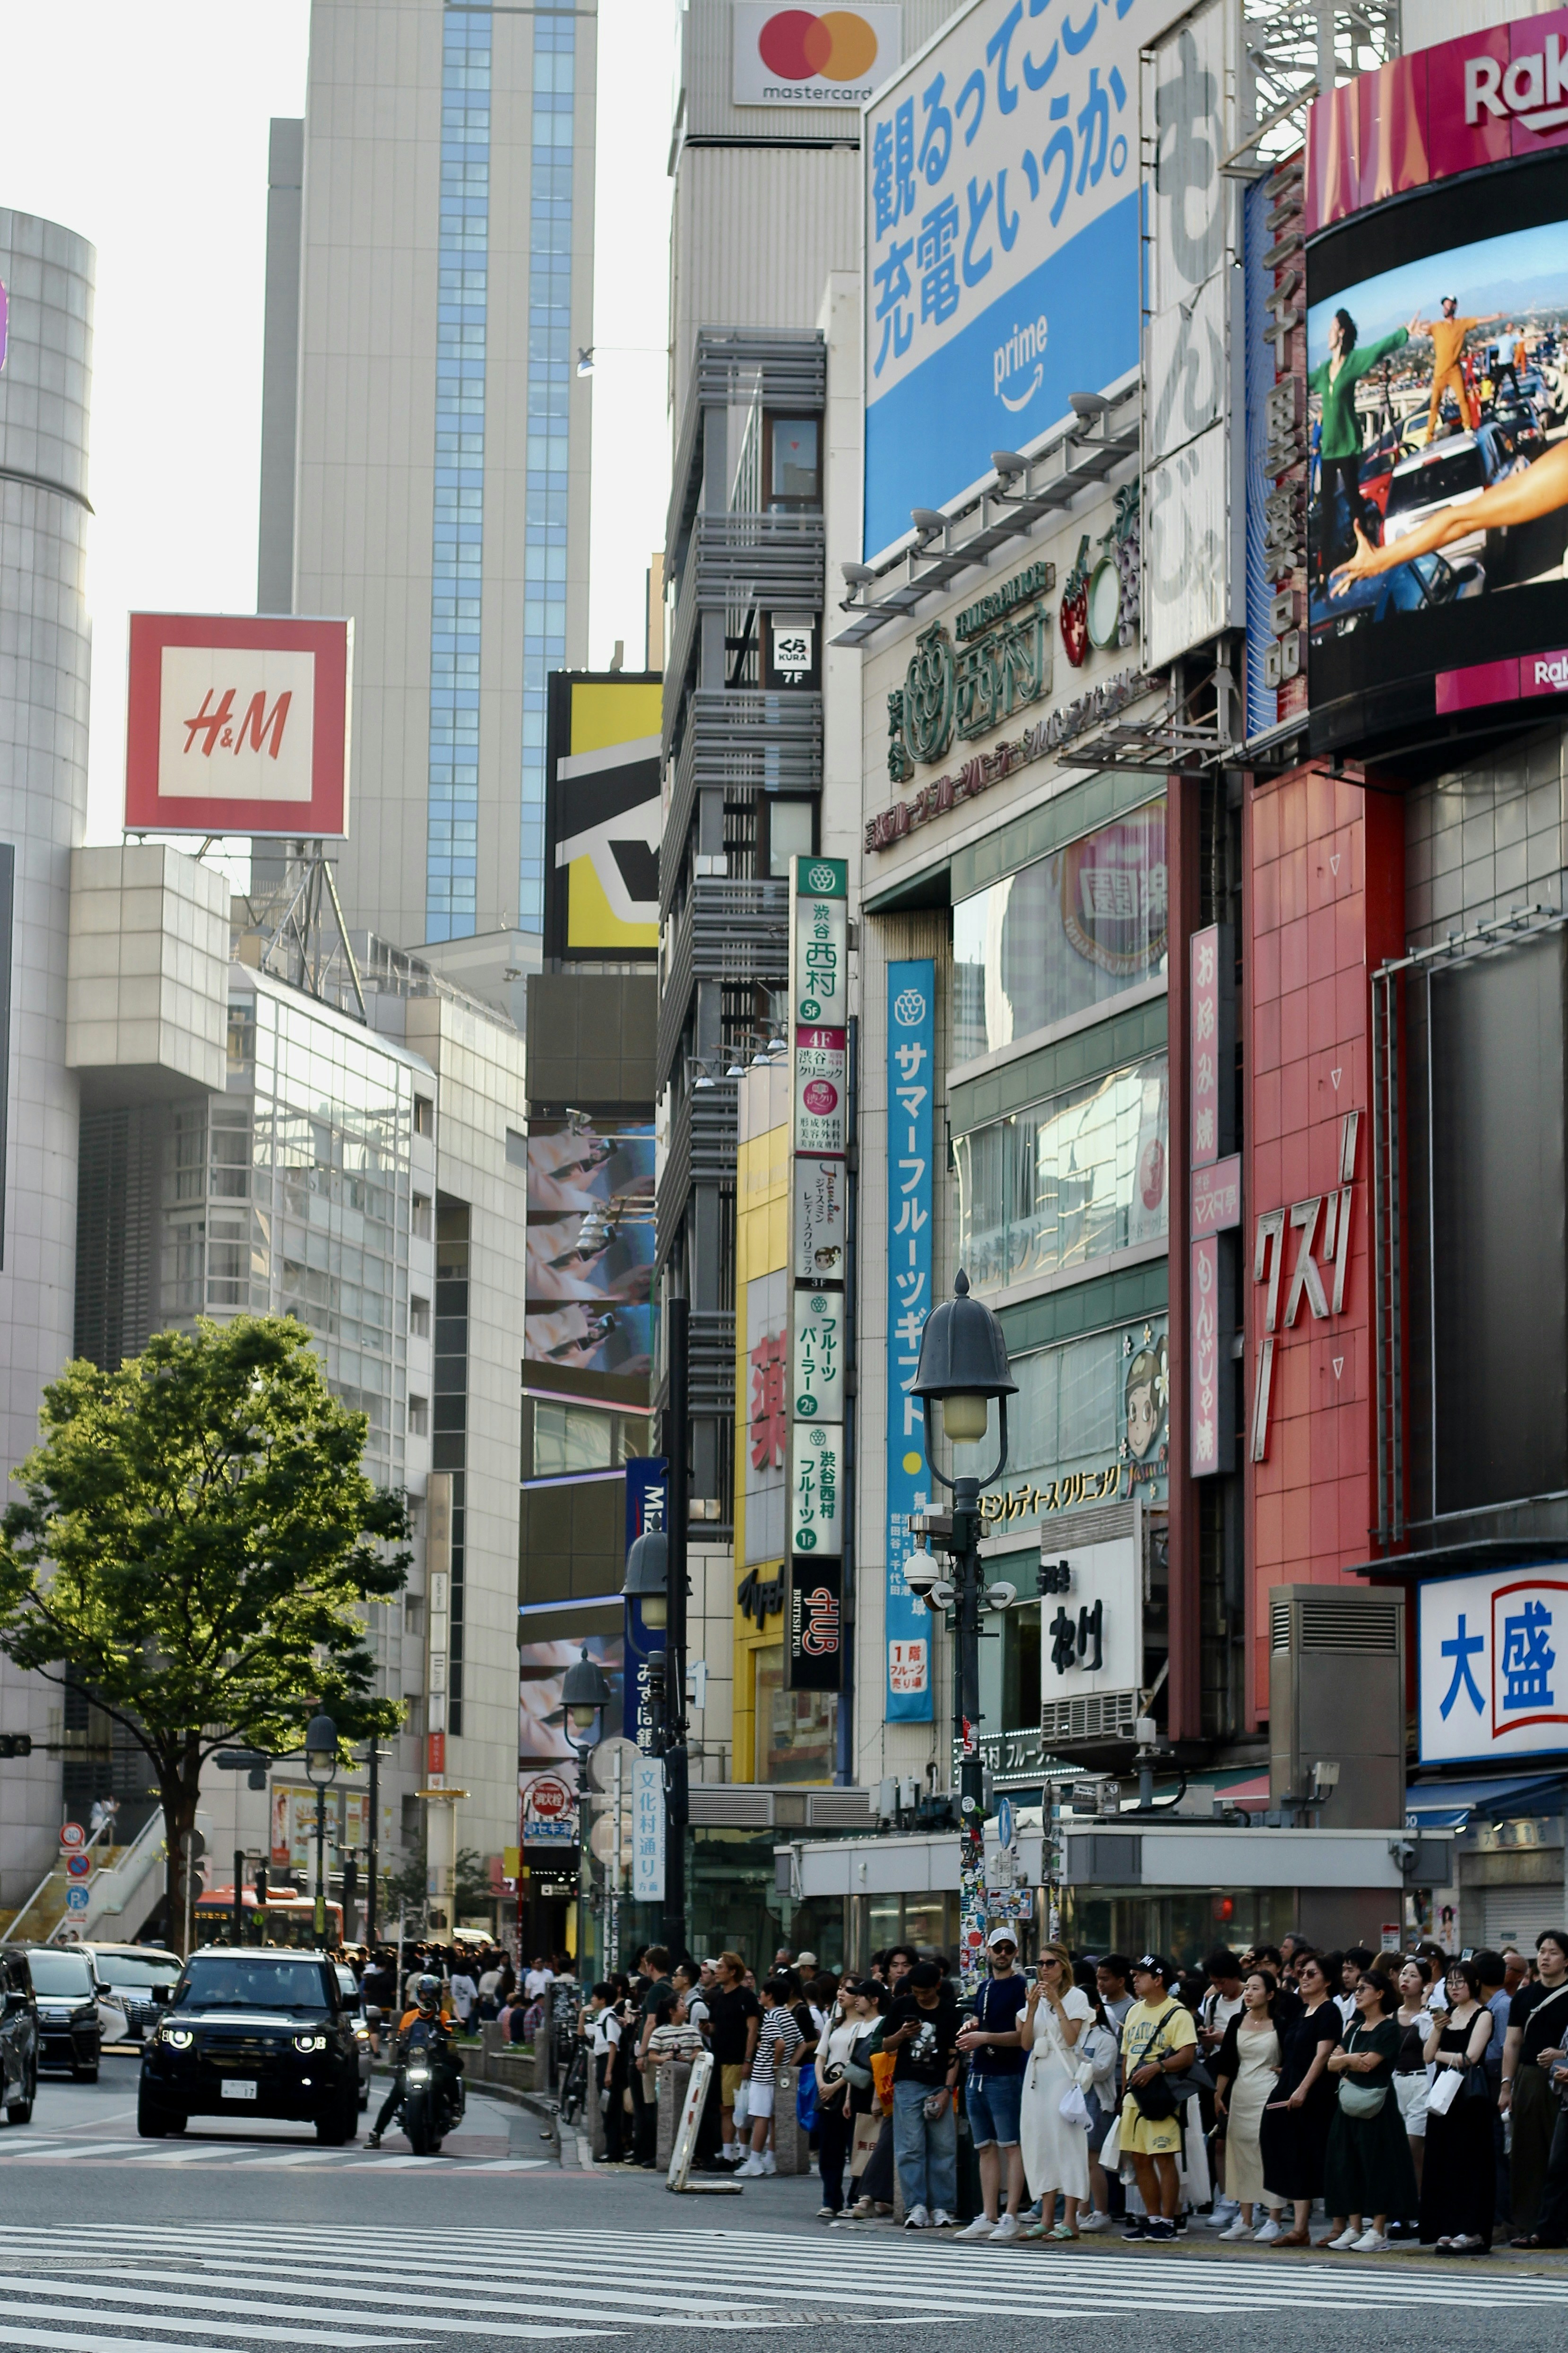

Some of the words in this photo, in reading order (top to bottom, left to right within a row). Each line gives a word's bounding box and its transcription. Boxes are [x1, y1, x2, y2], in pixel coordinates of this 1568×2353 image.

[762, 85, 873, 101] mastercard
[994, 315, 1048, 396] prime
[779, 638, 807, 652] くら
[779, 653, 807, 661] KURA
[782, 671, 803, 683] 7F
[954, 601, 1048, 741] 西村
[183, 687, 292, 760] H&M
[806, 904, 837, 997] 渋谷西村
[804, 1003, 818, 1017] 5F
[809, 1031, 833, 1046] 4F
[799, 1050, 826, 1065] 渋谷
[799, 1067, 842, 1079] クリニック
[800, 1118, 840, 1129] 形成外科
[801, 1129, 840, 1140] 美容外科
[815, 1178, 824, 1223] ジャスミン
[804, 1191, 813, 1275] レディースクリニック
[893, 1042, 928, 1435] サマーフルーツギフト
[811, 1278, 827, 1287] 3F
[800, 1327, 817, 1391] パーラー
[821, 1319, 837, 1382] フルーツ
[801, 1399, 815, 1413] 2F
[799, 1459, 815, 1524] フルーツ
[820, 1451, 835, 1519] 渋谷西村
[800, 1532, 814, 1546] 1F
[792, 1589, 801, 1633] BRITISH
[803, 1587, 839, 1655] HUB
[792, 1635, 801, 1657] PUB
[890, 1665, 926, 1676] フルーツ
[637, 1663, 652, 1759] みずほ銀
[534, 1792, 562, 1807] 消火栓
[639, 1770, 657, 1877] 文化村通り
